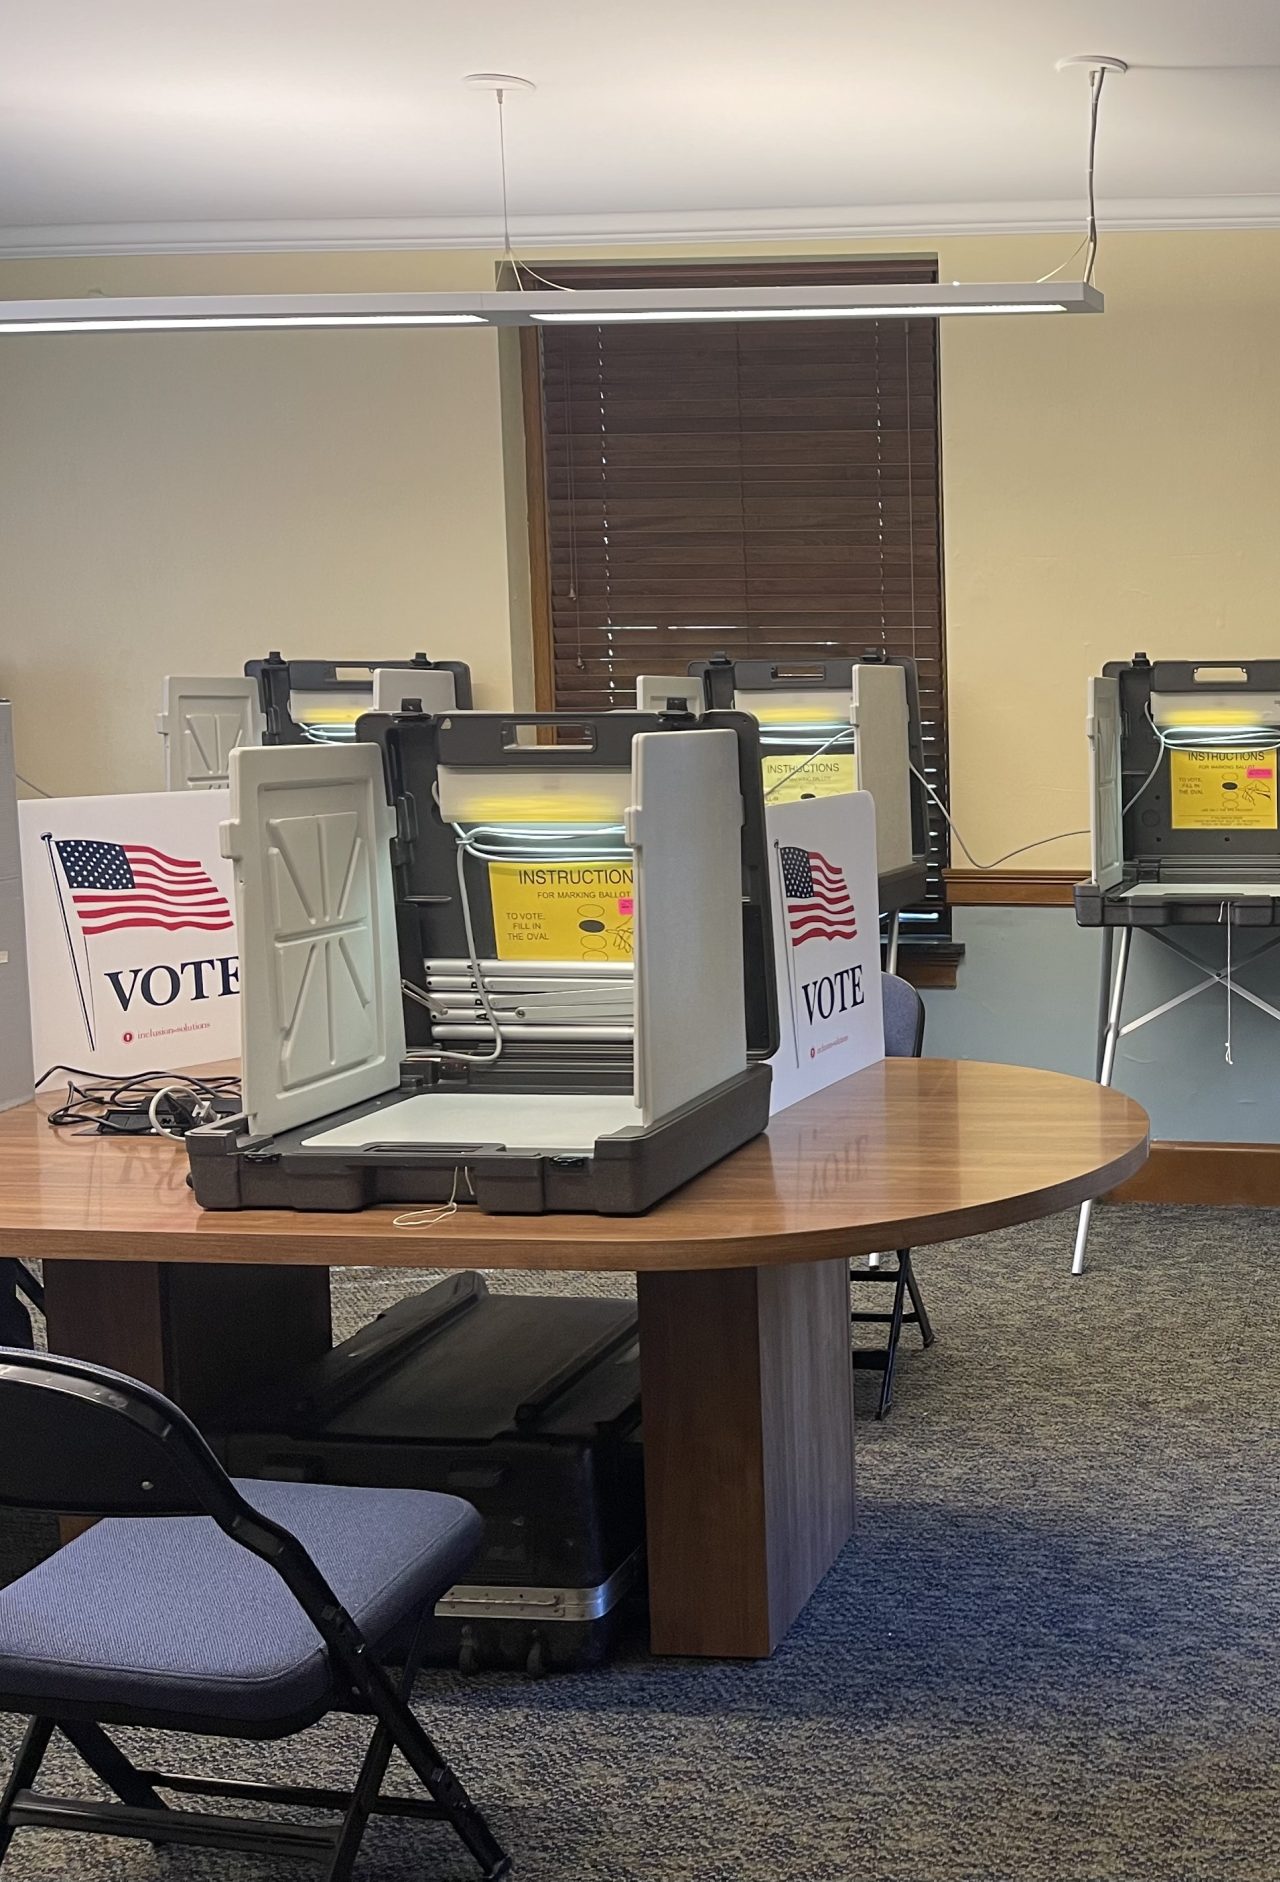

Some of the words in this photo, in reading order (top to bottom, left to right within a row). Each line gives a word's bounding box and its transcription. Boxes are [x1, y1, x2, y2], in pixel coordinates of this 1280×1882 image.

[1187, 751, 1265, 761] INSTRUCTIONS
[518, 869, 634, 885] INSTRUCTION
[537, 891, 555, 899] FOR
[557, 891, 596, 899] MARKING
[598, 891, 631, 899] BALLOT
[506, 912, 518, 920] TO
[512, 922, 530, 930] FILL
[532, 922, 541, 930] IN
[507, 932, 524, 941] THE
[526, 932, 550, 941] OVAL
[103, 956, 240, 1012] VOTE
[801, 964, 865, 1026] VOTE
